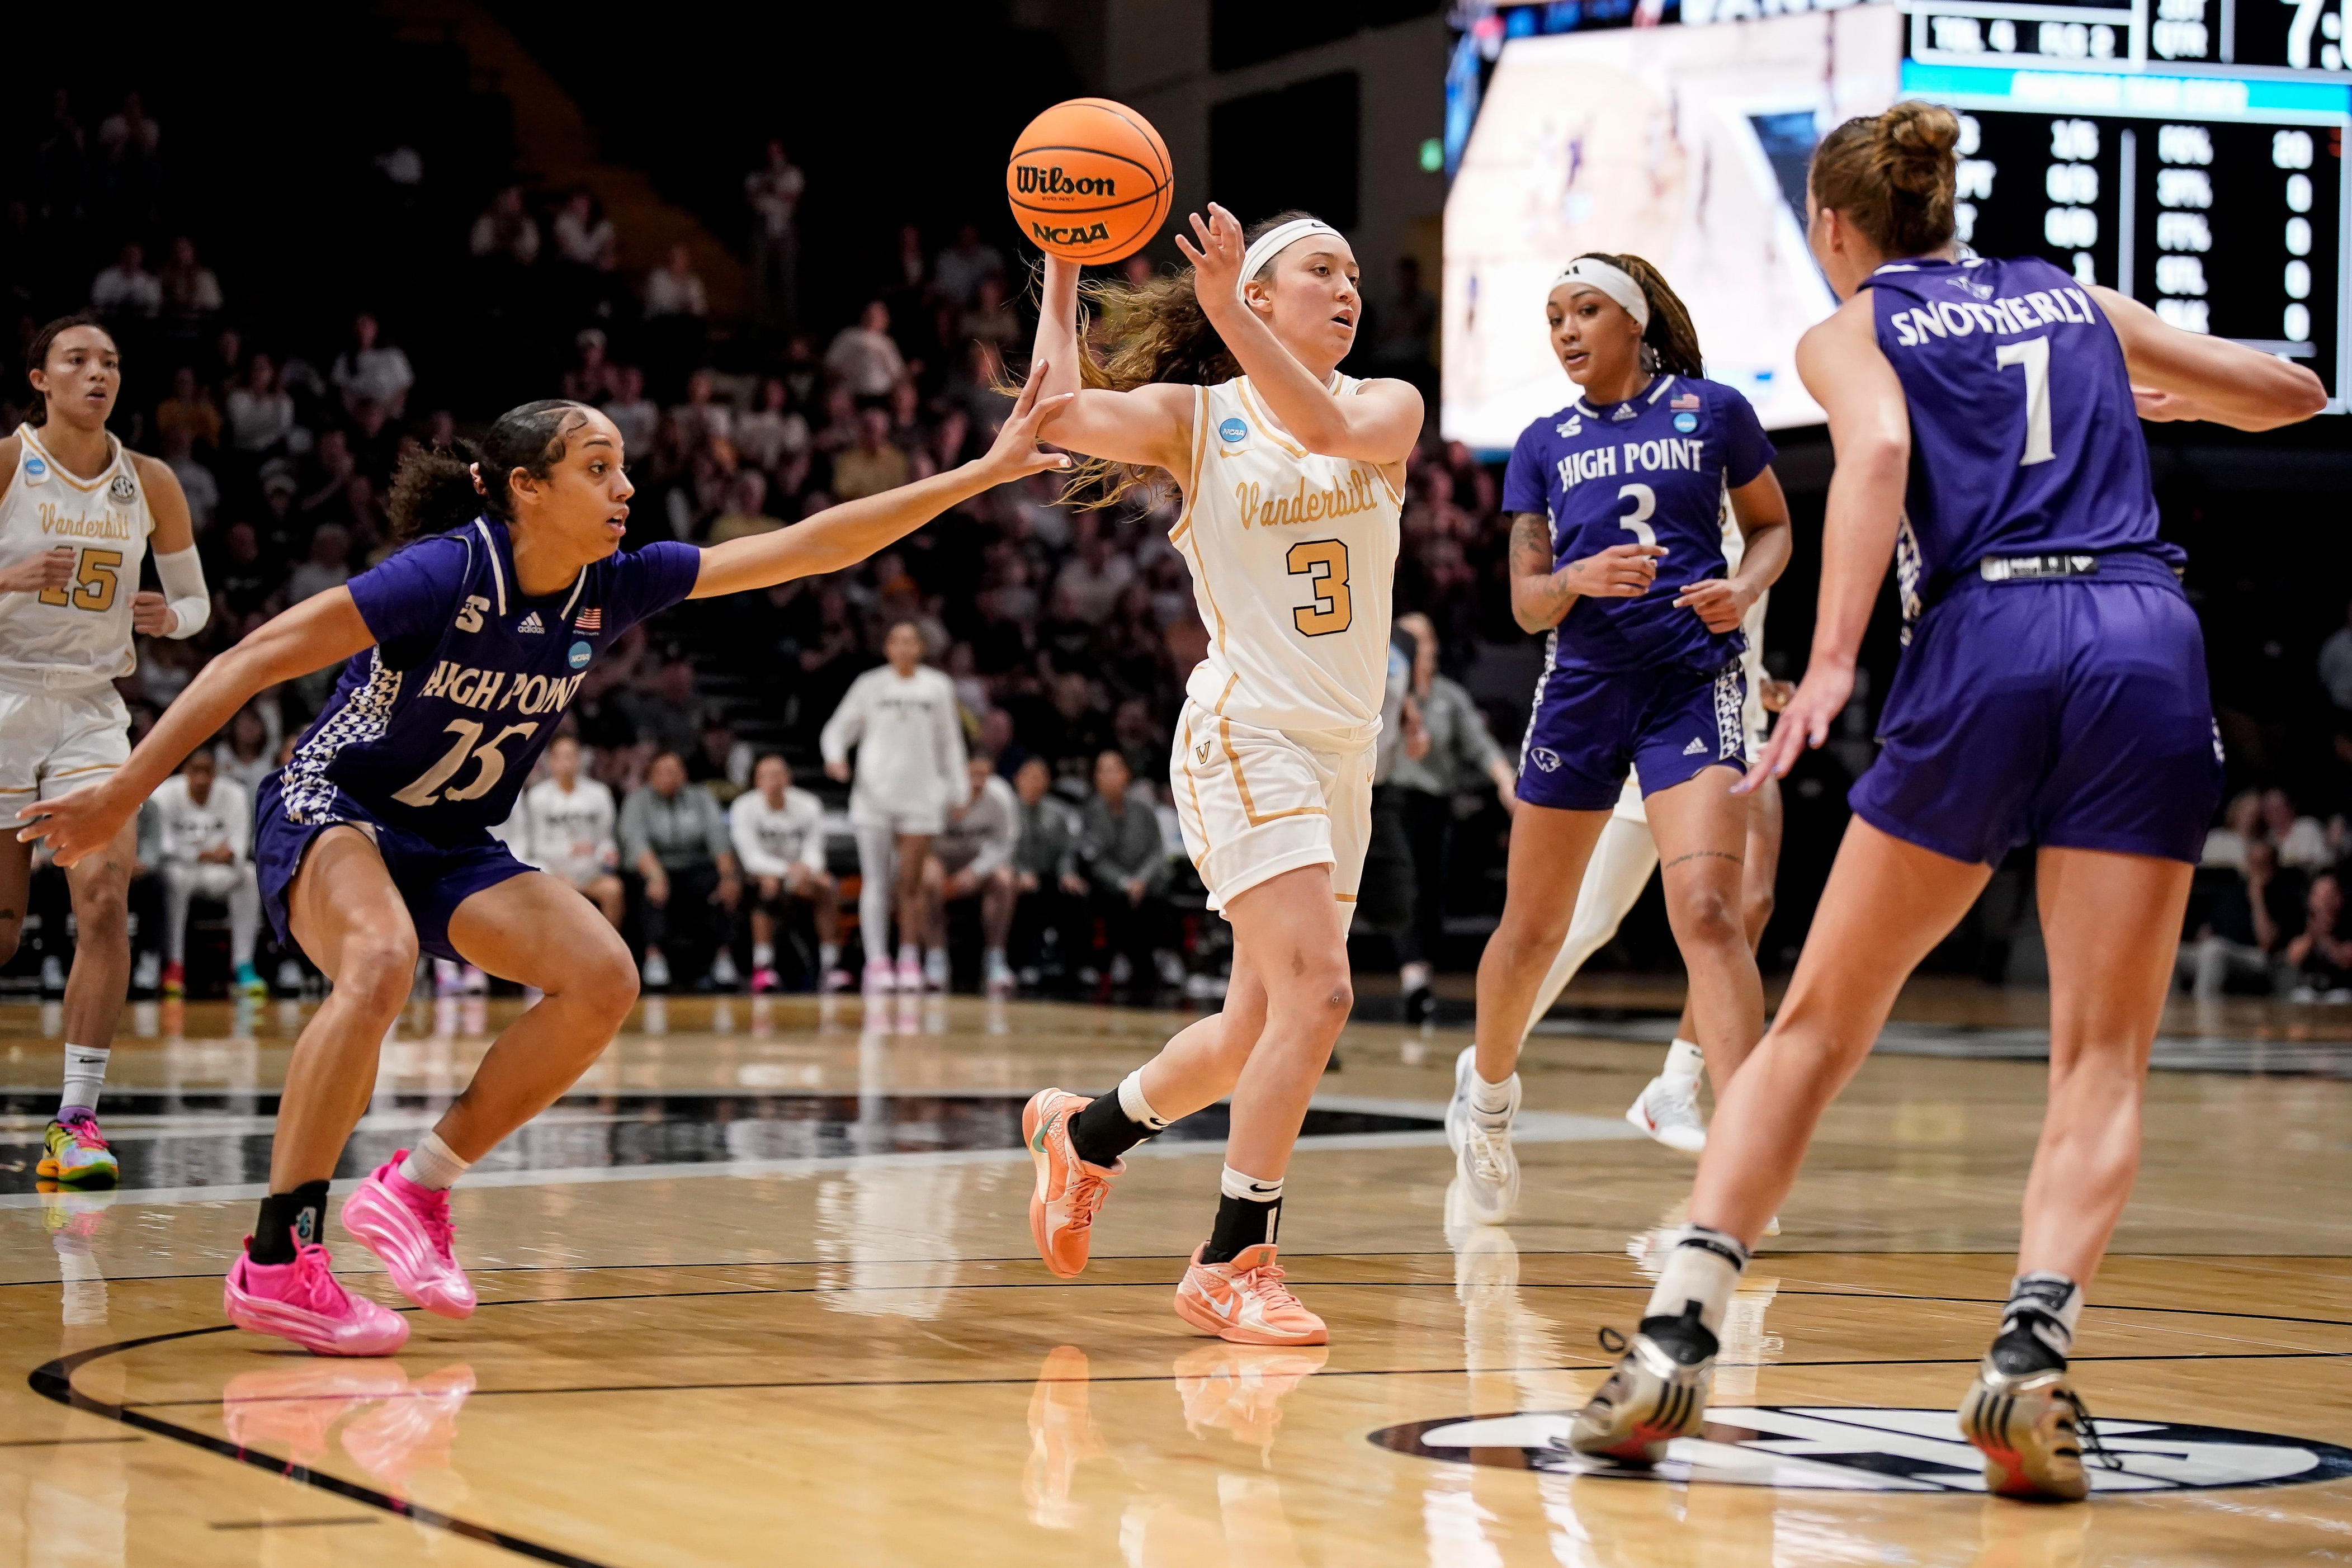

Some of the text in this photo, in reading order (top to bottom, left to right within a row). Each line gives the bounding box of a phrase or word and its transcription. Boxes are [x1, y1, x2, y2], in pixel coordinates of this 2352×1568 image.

[1017, 165, 1116, 197] Wilson
[1032, 221, 1109, 245] NCAA
[1891, 287, 2095, 346] SNOTHERLY
[1995, 335, 2056, 466] 7
[1557, 438, 1704, 493] HIGH POINT
[38, 503, 130, 540] Vanderbilt
[1236, 469, 1378, 530] Vanderbilt
[1617, 483, 1657, 547] 3
[1286, 539, 1352, 637] 3
[518, 625, 545, 634] adidas
[417, 660, 587, 715] HIGH POINT
[391, 718, 539, 807] 25
